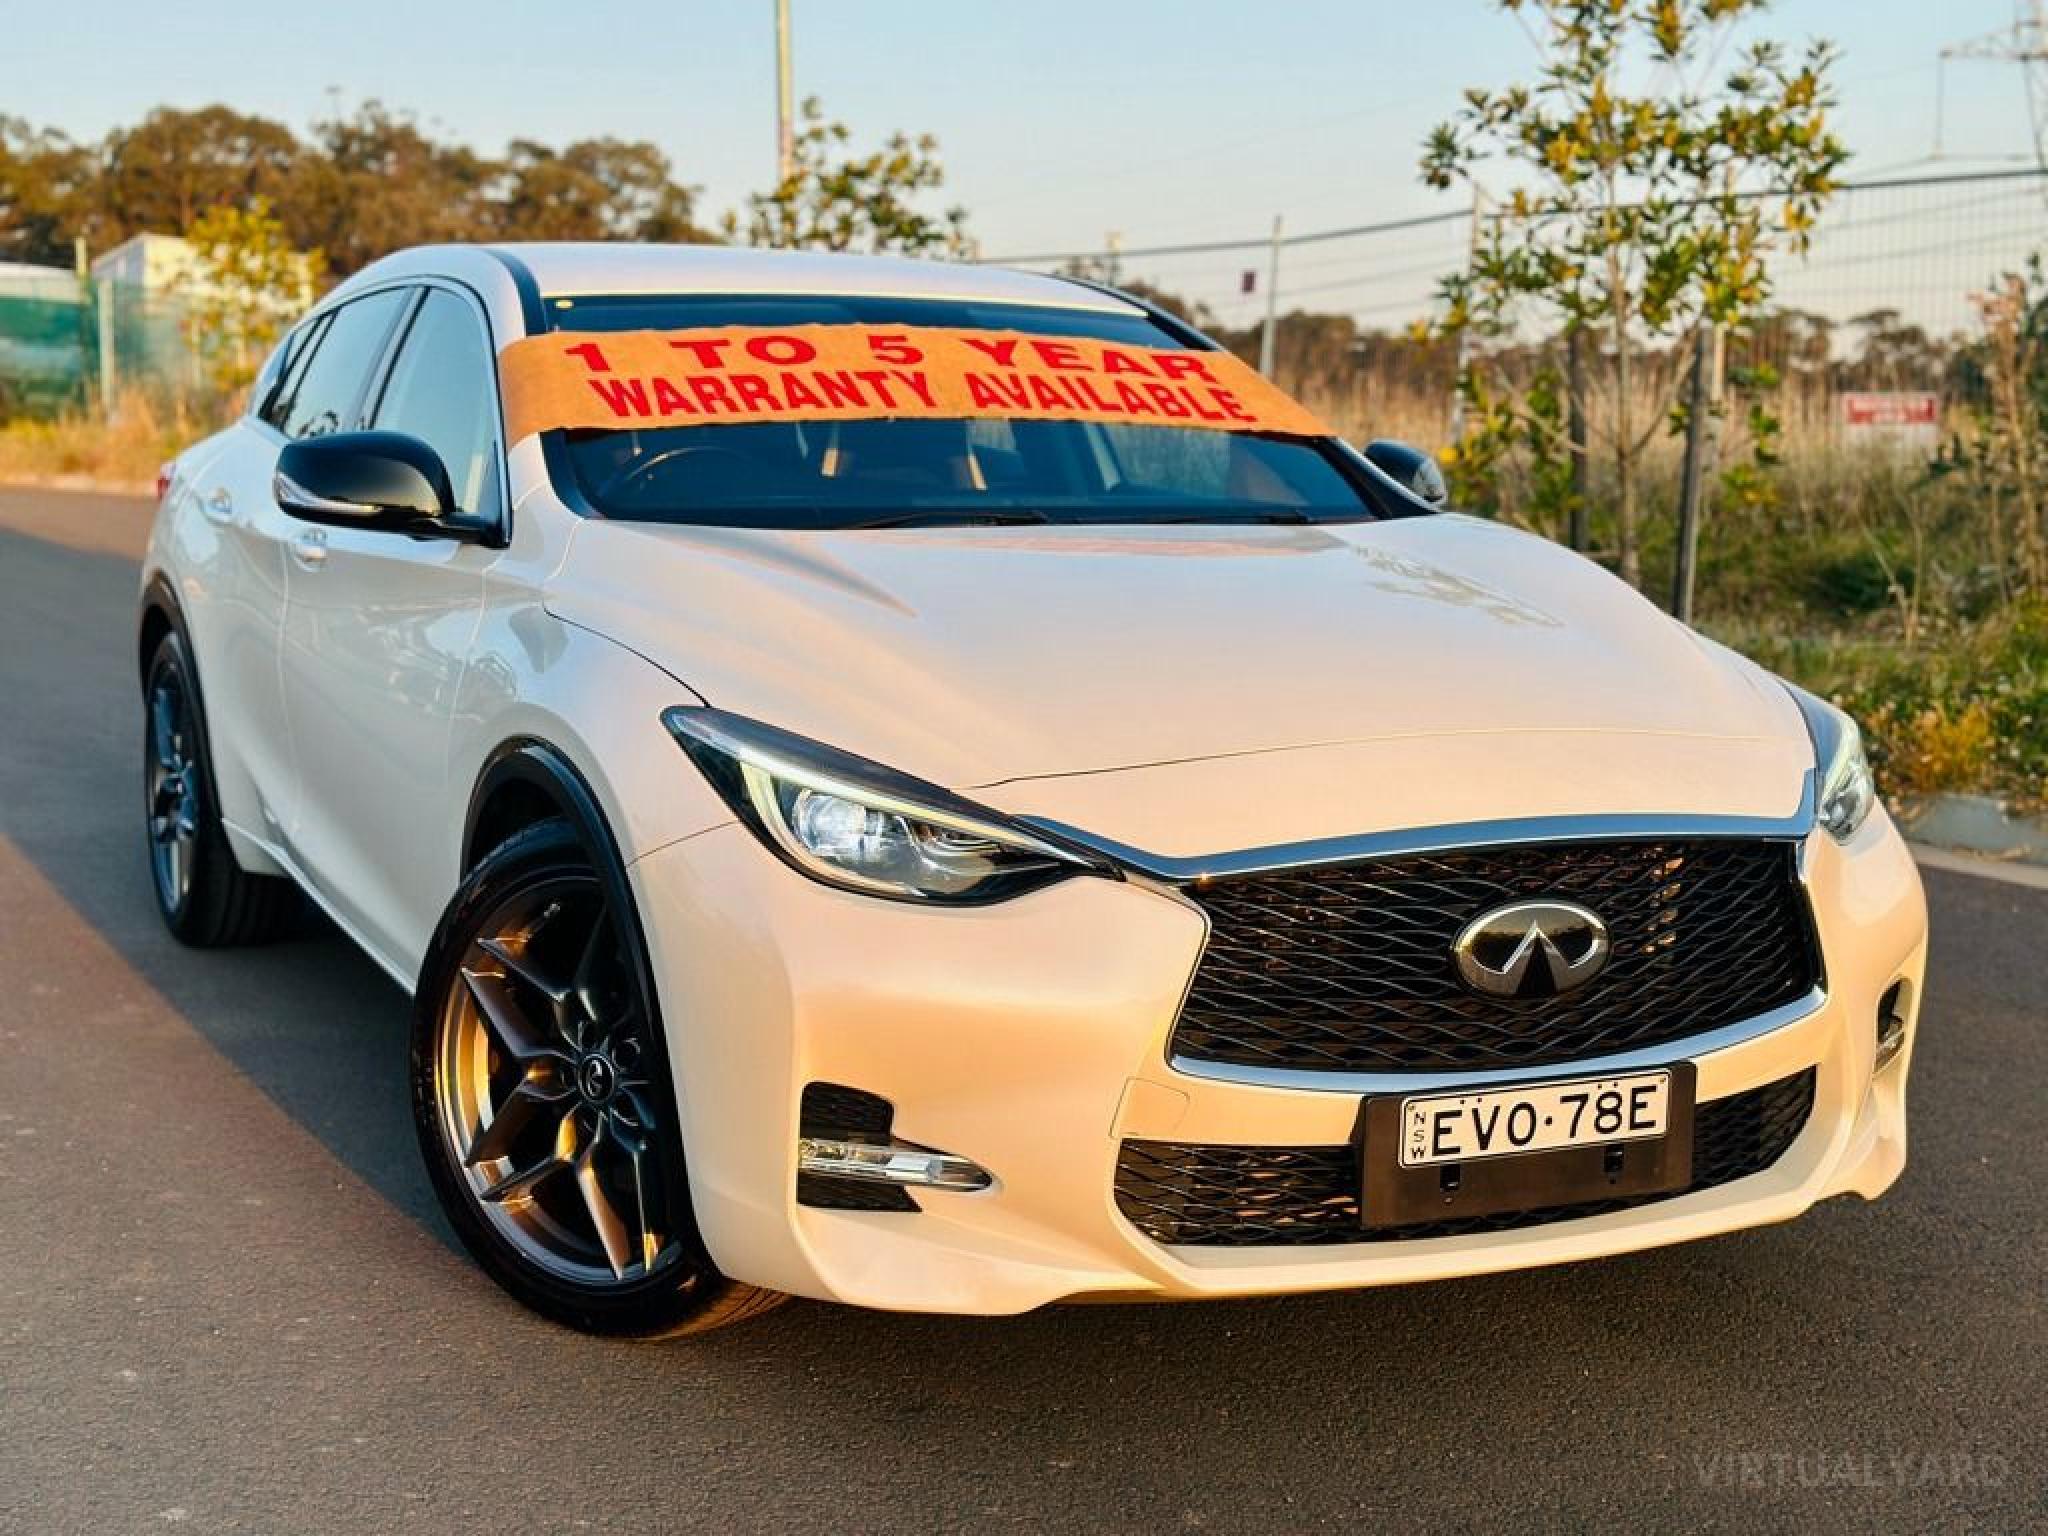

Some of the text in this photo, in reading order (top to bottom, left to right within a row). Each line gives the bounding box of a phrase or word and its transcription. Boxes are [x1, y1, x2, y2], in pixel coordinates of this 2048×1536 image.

[565, 335, 1220, 385] 1 TO 5 YEAR
[587, 369, 1258, 423] WARRANTY AVAILABLE
